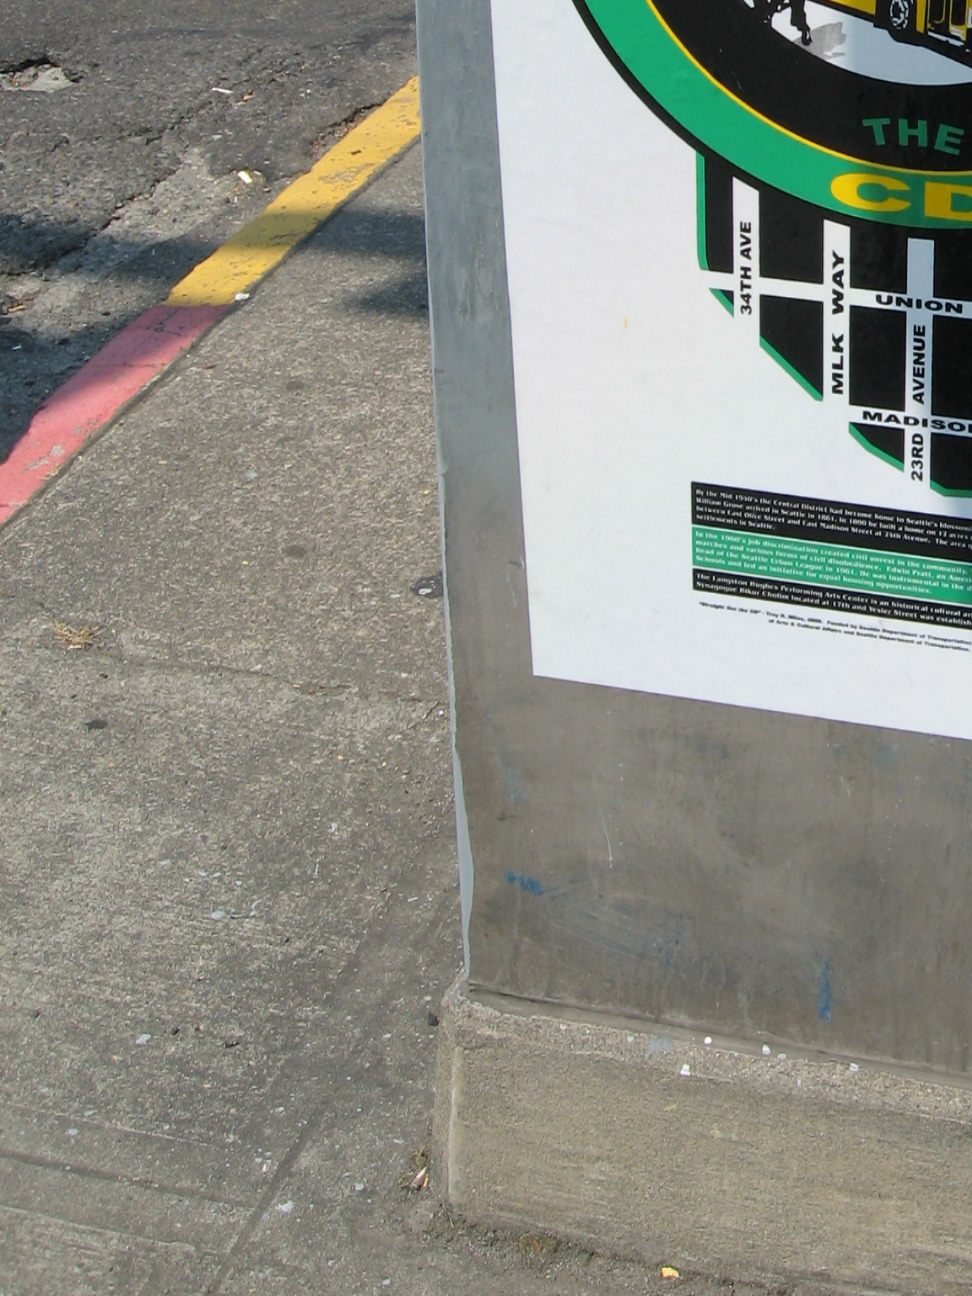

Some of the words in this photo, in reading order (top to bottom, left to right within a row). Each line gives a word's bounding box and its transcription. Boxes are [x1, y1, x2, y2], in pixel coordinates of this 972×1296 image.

[862, 116, 966, 156] THE
[739, 220, 753, 261] AVE
[739, 261, 753, 316] 34TH
[831, 250, 845, 316] WAY
[875, 293, 963, 315] UNION
[831, 333, 845, 396] MLK
[912, 324, 926, 406] AVENUE
[910, 433, 925, 482] 23RD
